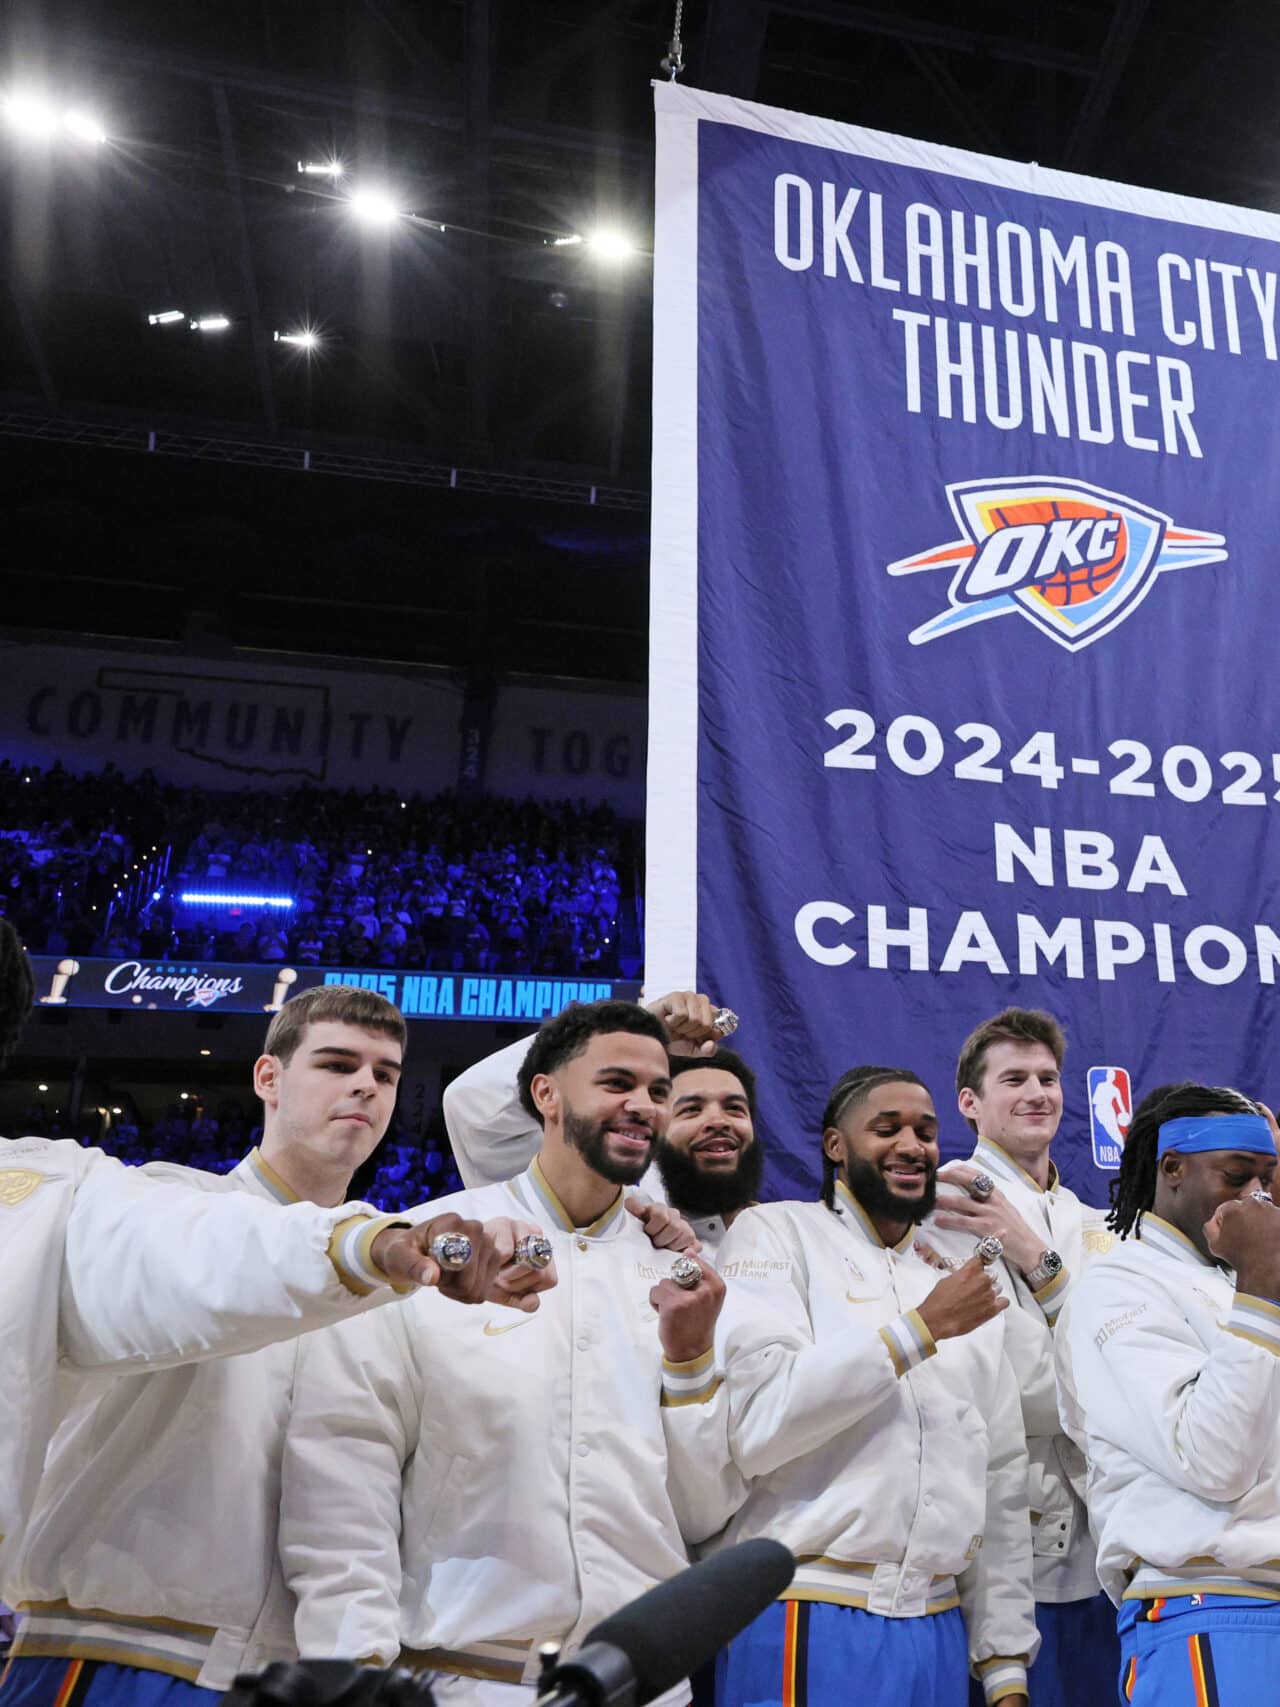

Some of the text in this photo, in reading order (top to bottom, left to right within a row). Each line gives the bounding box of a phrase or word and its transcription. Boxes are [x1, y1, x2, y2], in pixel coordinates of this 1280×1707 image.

[774, 172, 1279, 361] OKLAHOMA CITY
[892, 308, 1204, 458] THUNDER
[967, 518, 1120, 595] OKC
[27, 687, 414, 763] COMMUNITY
[527, 727, 630, 777] TOG
[993, 822, 1188, 896] NBA
[104, 961, 243, 1001] Champions
[401, 975, 454, 1015] NBA
[1100, 1145, 1121, 1162] NBA
